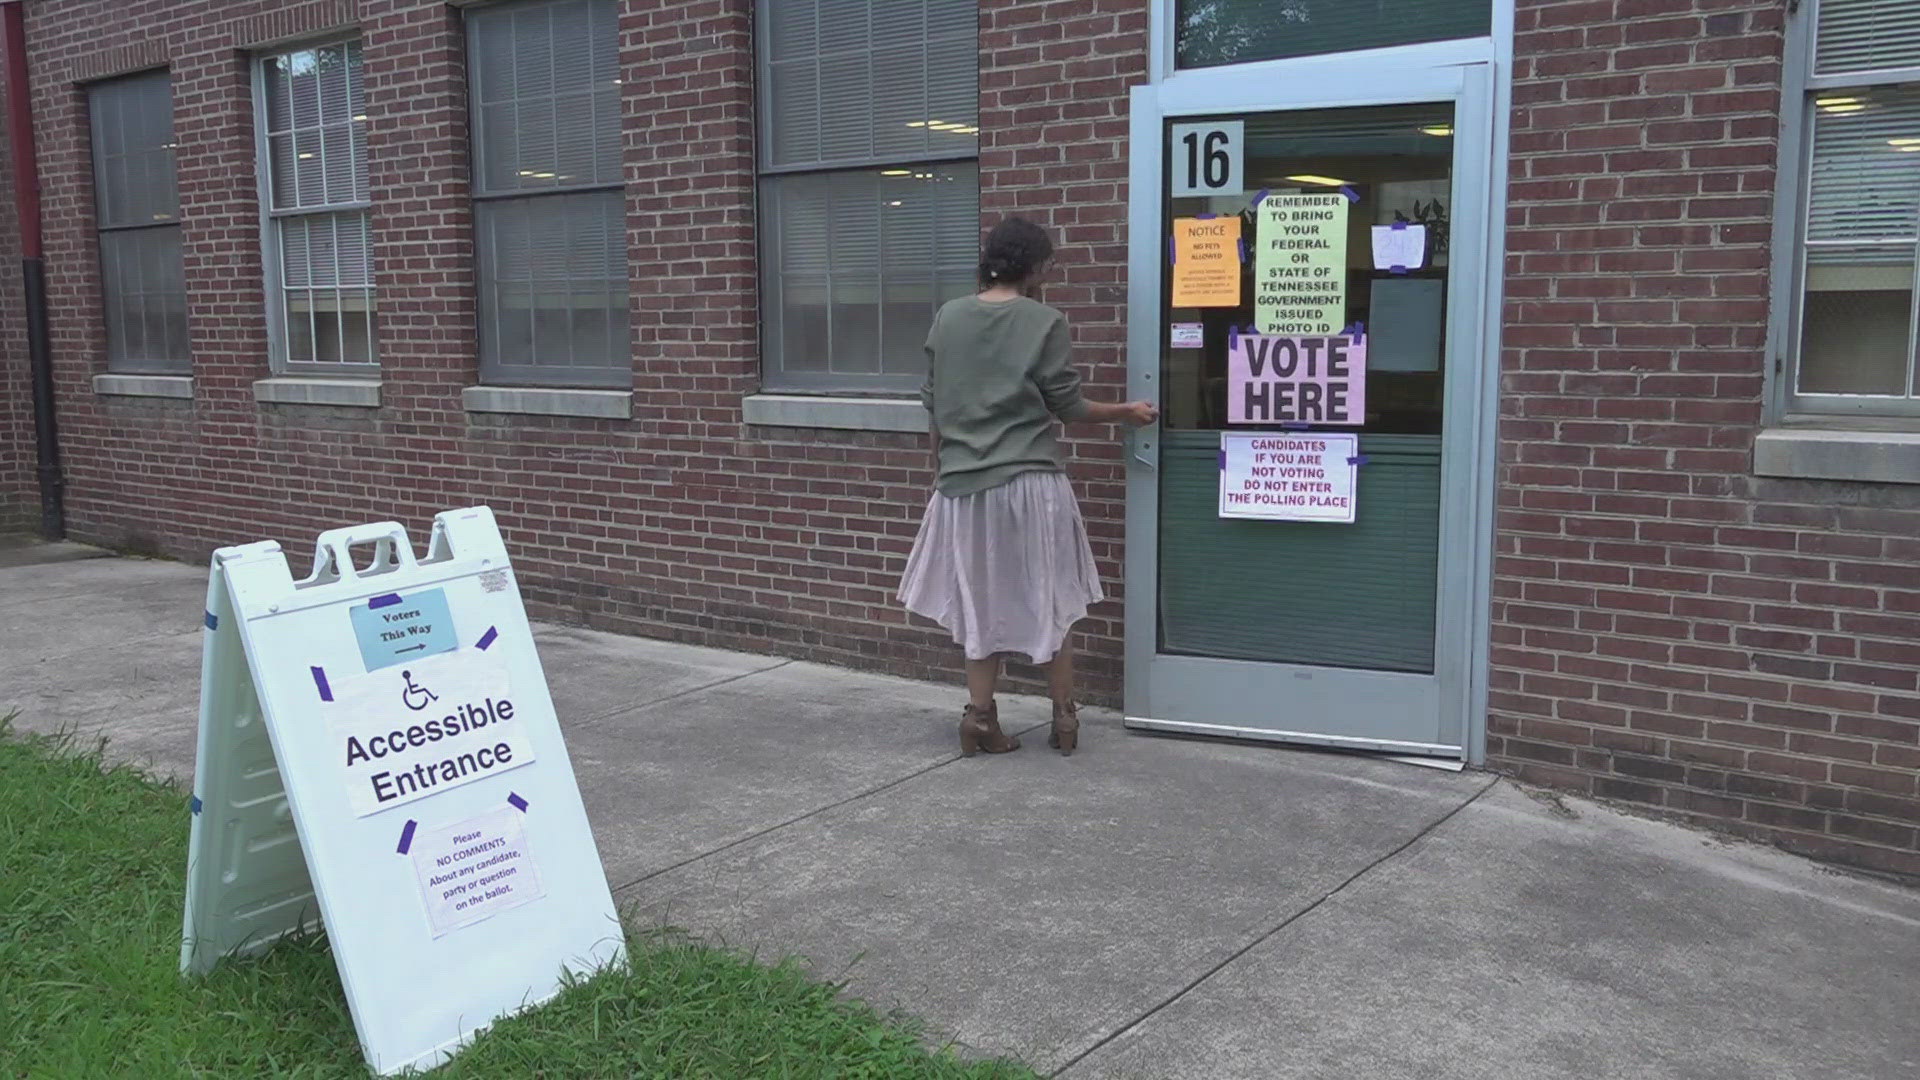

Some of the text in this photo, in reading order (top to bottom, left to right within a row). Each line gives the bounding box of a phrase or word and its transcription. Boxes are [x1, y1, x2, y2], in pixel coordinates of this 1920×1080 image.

[1182, 131, 1230, 189] 16
[1266, 196, 1340, 208] REMEMBER
[1270, 211, 1334, 222] TO BRING
[1188, 225, 1226, 237] NOTICE
[1283, 225, 1320, 235] YOUR
[1271, 239, 1330, 250] FEDERAL
[1291, 253, 1310, 264] OR
[1269, 268, 1331, 278] STATE OF
[1262, 282, 1339, 292] TENNESSEE
[1257, 295, 1342, 306] GOVERNMENT
[1275, 309, 1324, 320] ISSUED
[1268, 323, 1330, 333] PHOTO ID
[1244, 338, 1349, 377] VOTE
[1245, 382, 1348, 420] HERE
[1251, 440, 1326, 452] CANDIDATES
[1255, 453, 1322, 465] IF YOU ARE
[1251, 467, 1325, 479] NOT VOTING
[1244, 480, 1332, 493] DO NOT ENTER
[1227, 493, 1348, 508] THE POLLING PLACE
[382, 609, 421, 624] Voters
[380, 624, 432, 642] This Way
[347, 698, 514, 767] Accessible
[370, 741, 513, 804] Entrance
[453, 831, 482, 845] Please
[436, 837, 506, 867] NO COMMENTS
[429, 850, 521, 887] About any candidate,
[443, 867, 516, 900] party or question
[456, 885, 513, 911] on the ballot.
